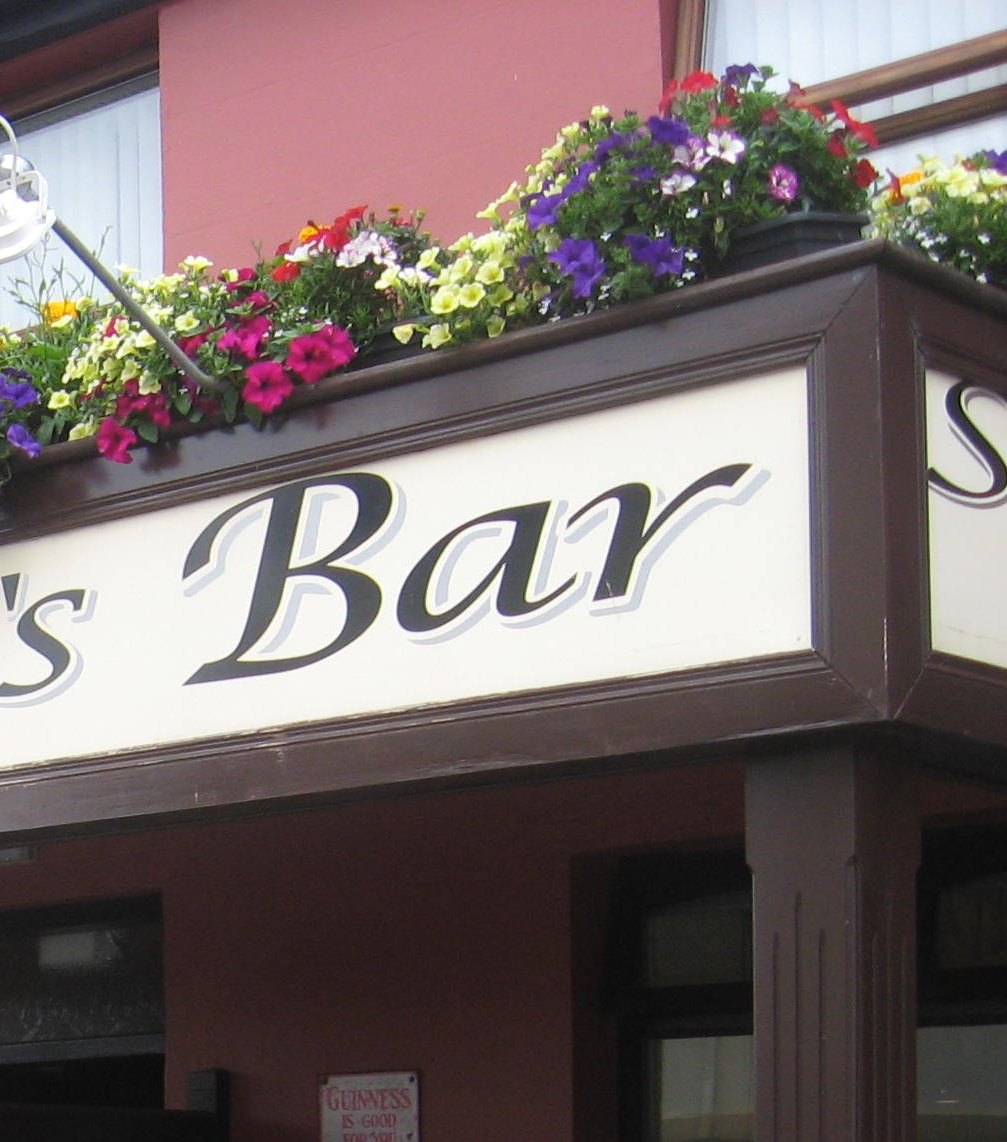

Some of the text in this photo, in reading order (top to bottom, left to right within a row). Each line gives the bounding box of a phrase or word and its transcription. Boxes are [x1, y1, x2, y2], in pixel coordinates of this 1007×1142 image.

[182, 462, 761, 685] Bar
[327, 1086, 412, 1111] GUINNESS
[342, 1113, 397, 1129] IS GOOD
